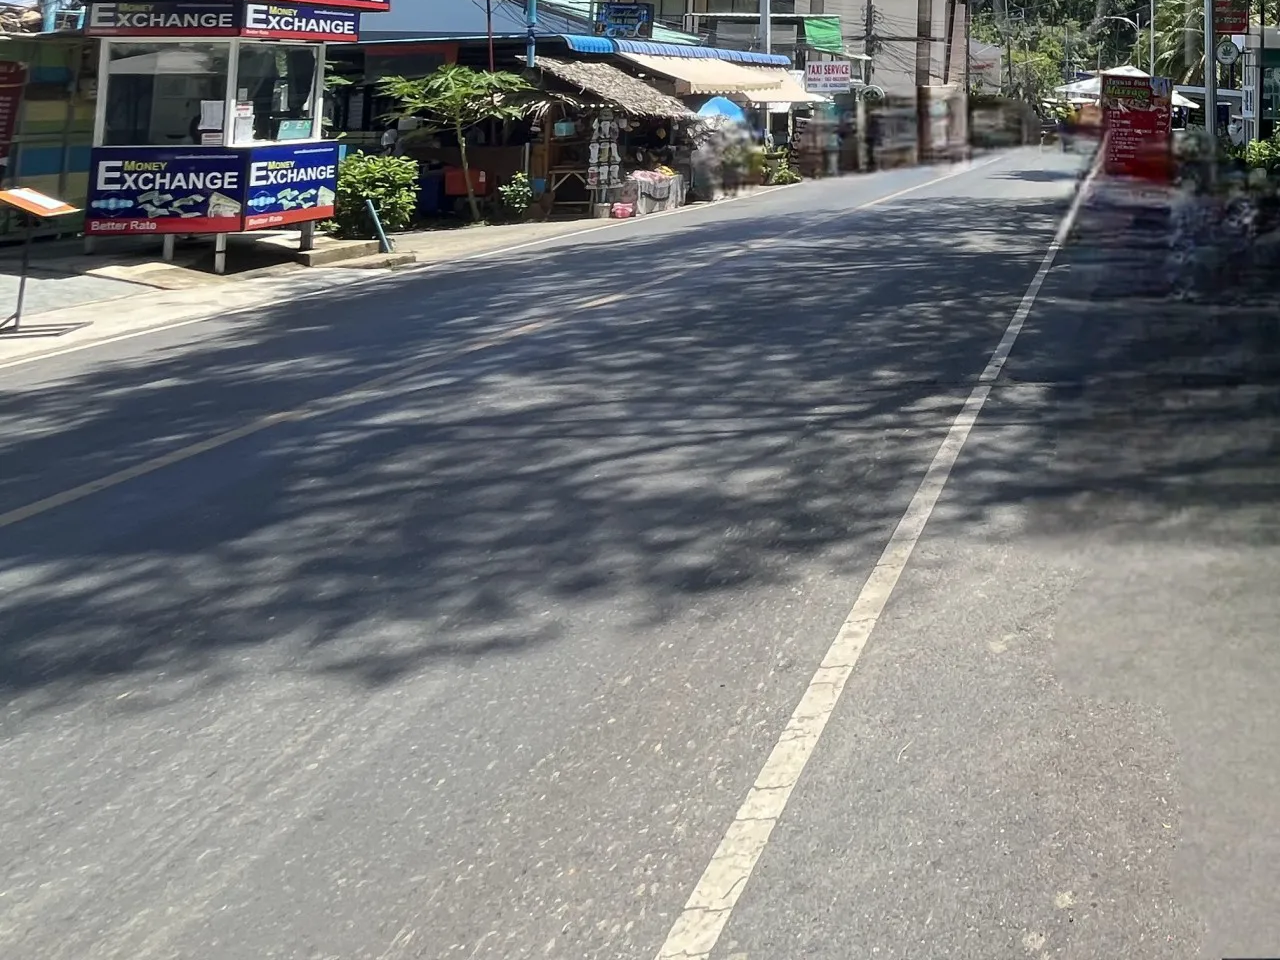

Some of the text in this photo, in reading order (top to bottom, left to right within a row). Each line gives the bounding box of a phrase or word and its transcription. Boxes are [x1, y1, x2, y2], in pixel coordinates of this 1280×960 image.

[90, 3, 233, 27] EXCHANGE
[269, 6, 298, 16] MONEY
[246, 4, 355, 34] EXCHANGE
[808, 64, 849, 75] TAXI SERVICE
[1106, 85, 1149, 99] Massage
[282, 120, 313, 129] OEN
[124, 160, 168, 171] MONEY
[267, 160, 296, 170] MONEY
[97, 160, 239, 190] EXCHANGE
[249, 161, 336, 186] EXCHANGE
[91, 220, 157, 231] Better Rate
